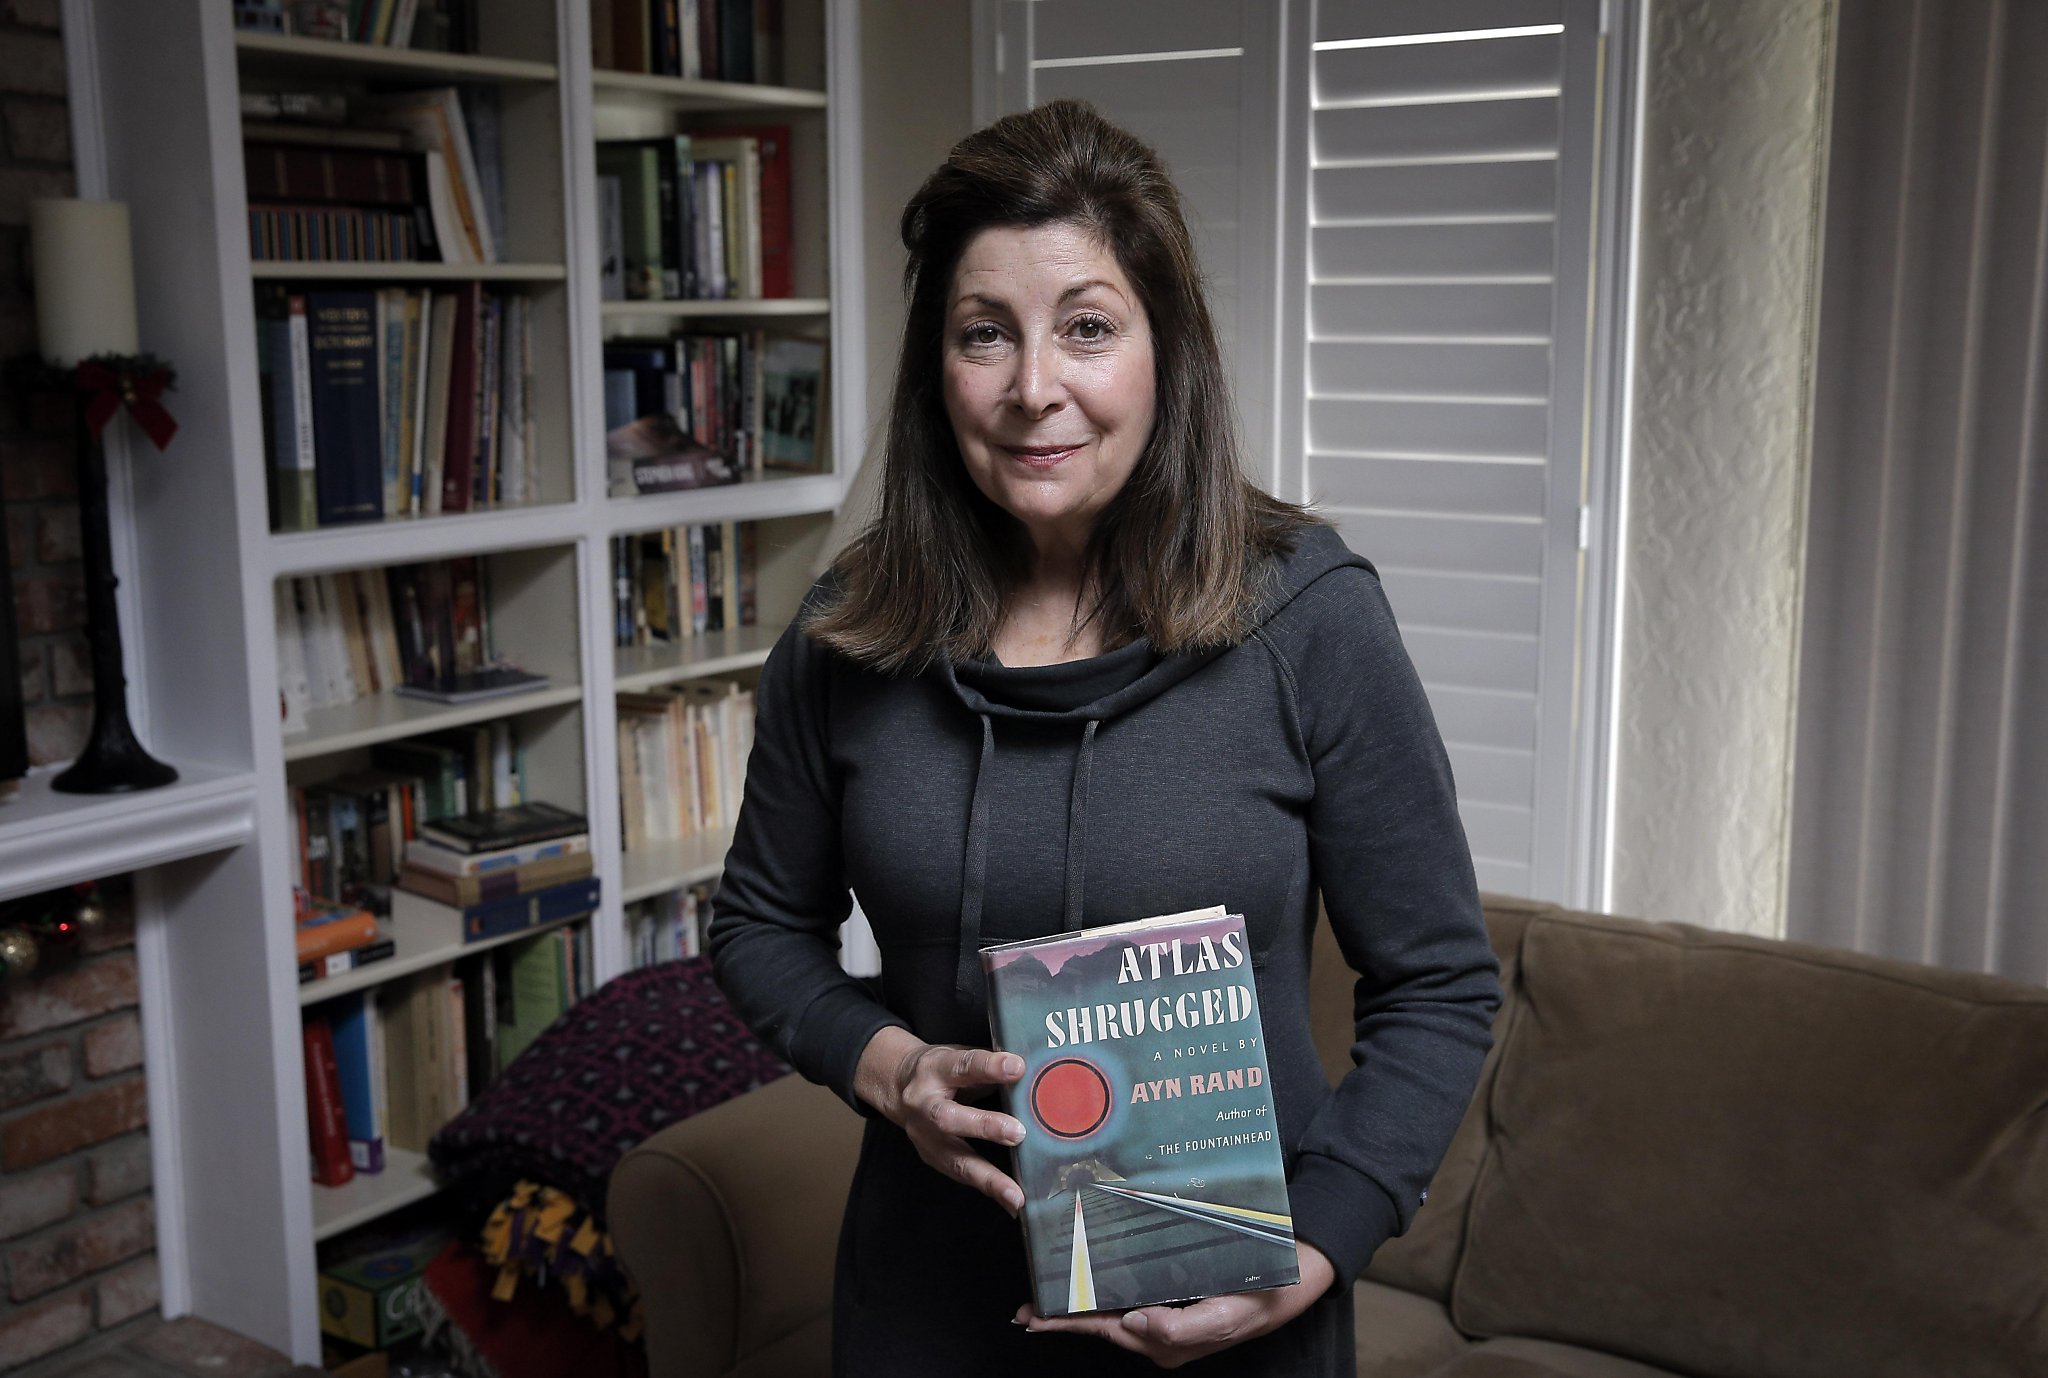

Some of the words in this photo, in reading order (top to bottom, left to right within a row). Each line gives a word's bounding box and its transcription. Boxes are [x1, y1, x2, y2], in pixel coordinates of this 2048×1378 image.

[1117, 931, 1244, 984] ATLAS
[1045, 985, 1252, 1048] SHRUGGED
[1153, 1051, 1162, 1062] A
[1174, 1041, 1229, 1059] NOVEL
[1238, 1037, 1258, 1049] BY
[1130, 1077, 1182, 1104] AYN
[1189, 1066, 1263, 1096] RAND
[1215, 1107, 1252, 1122] Author
[1255, 1104, 1268, 1117] of
[1158, 1144, 1180, 1156] THE
[1185, 1130, 1272, 1153] FOUNTAINHEAD
